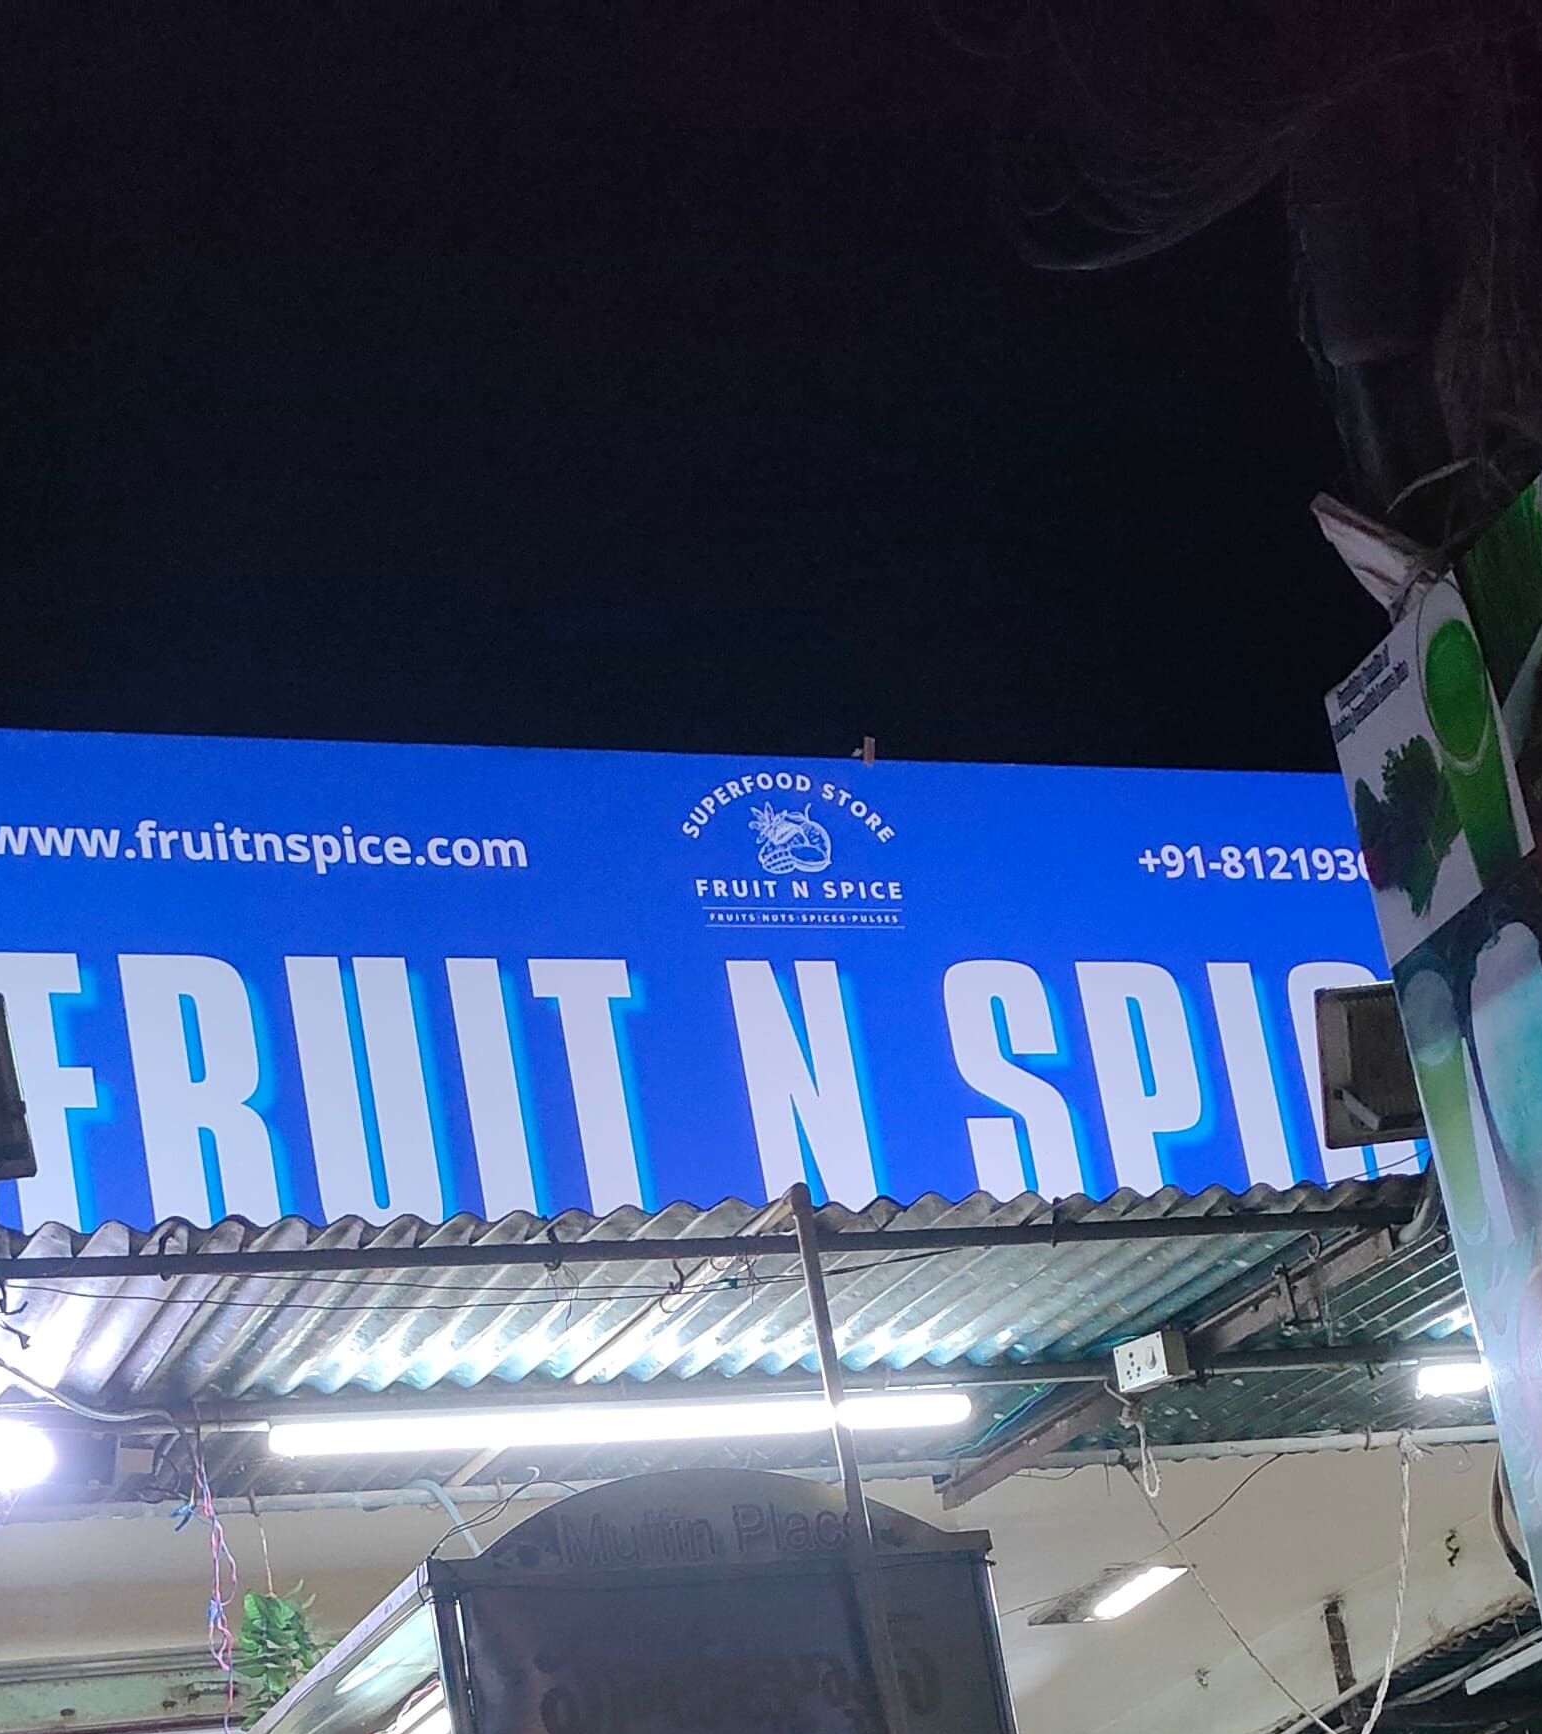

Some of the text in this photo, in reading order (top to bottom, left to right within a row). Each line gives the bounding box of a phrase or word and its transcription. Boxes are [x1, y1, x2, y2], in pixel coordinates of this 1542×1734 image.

[682, 772, 896, 843] SUPERFOOD STORE
[695, 879, 903, 900] FRUIT N SPICE
[726, 960, 859, 1212] N
[942, 958, 1421, 1203] SPIC
